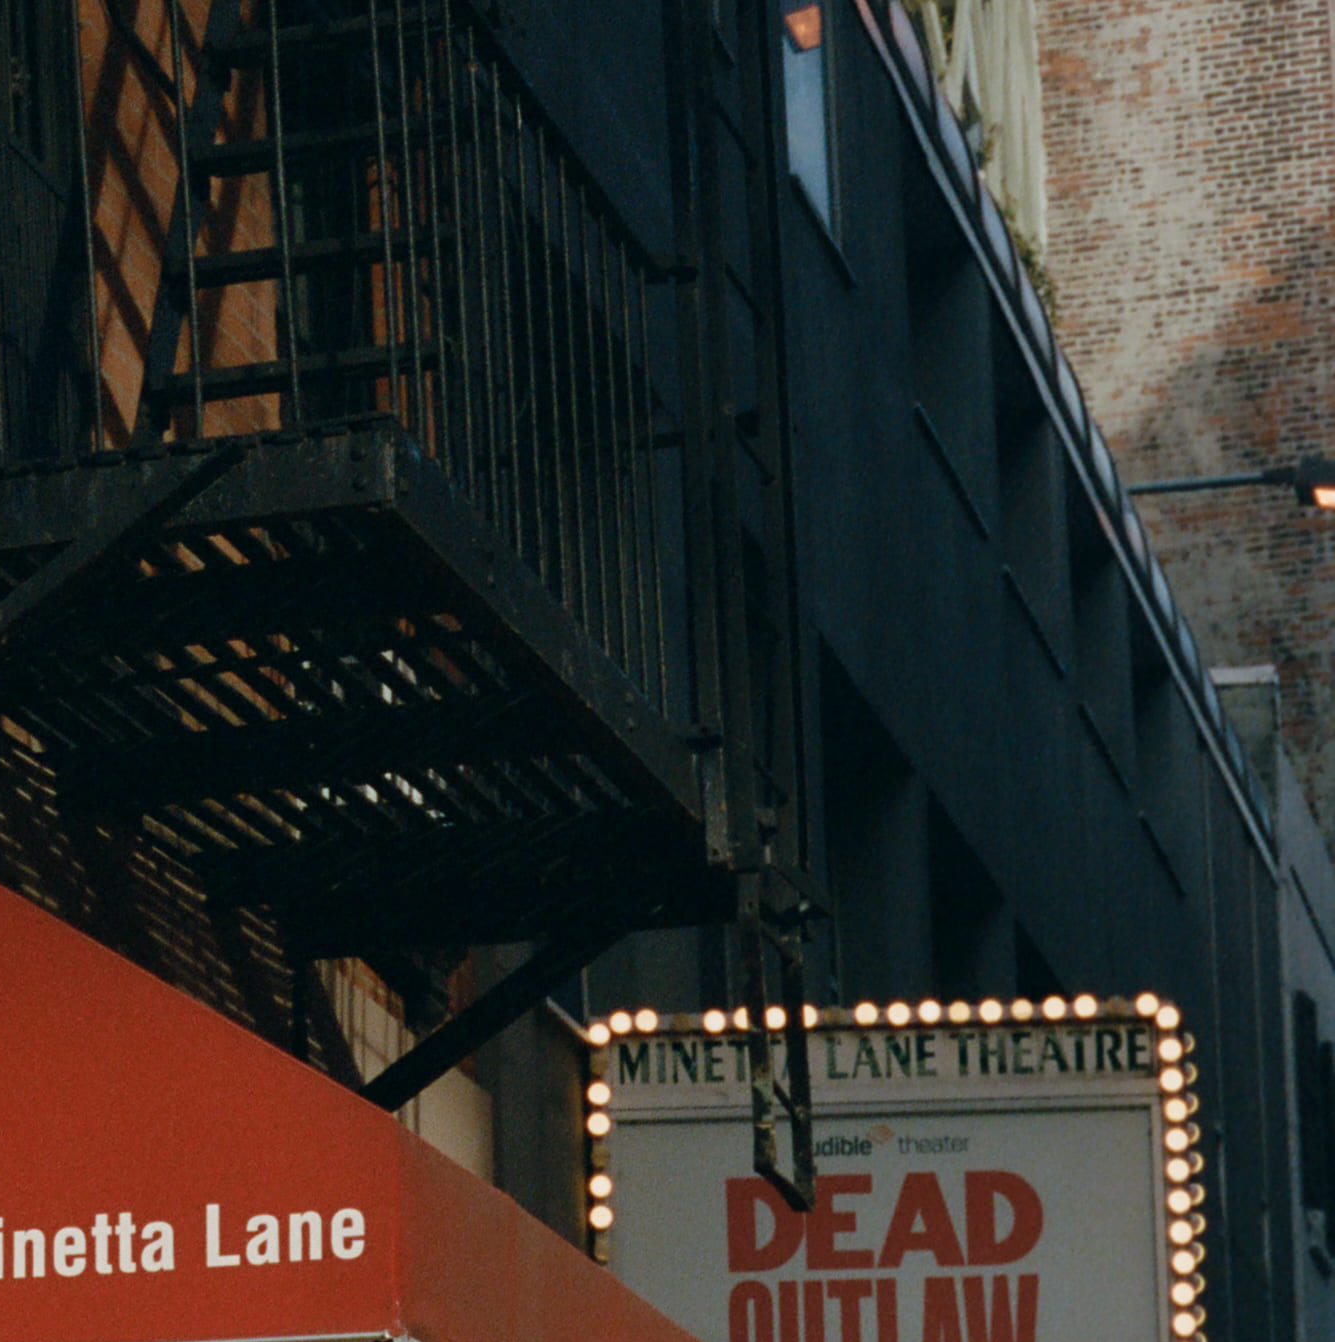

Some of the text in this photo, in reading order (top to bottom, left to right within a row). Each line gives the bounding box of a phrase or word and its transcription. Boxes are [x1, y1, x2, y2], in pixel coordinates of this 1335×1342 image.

[618, 1025, 1151, 1085] MINET LANE THEATRE
[812, 1134, 970, 1157] udible theater
[205, 1203, 366, 1268] Lane
[725, 1169, 1044, 1273] DEAD
